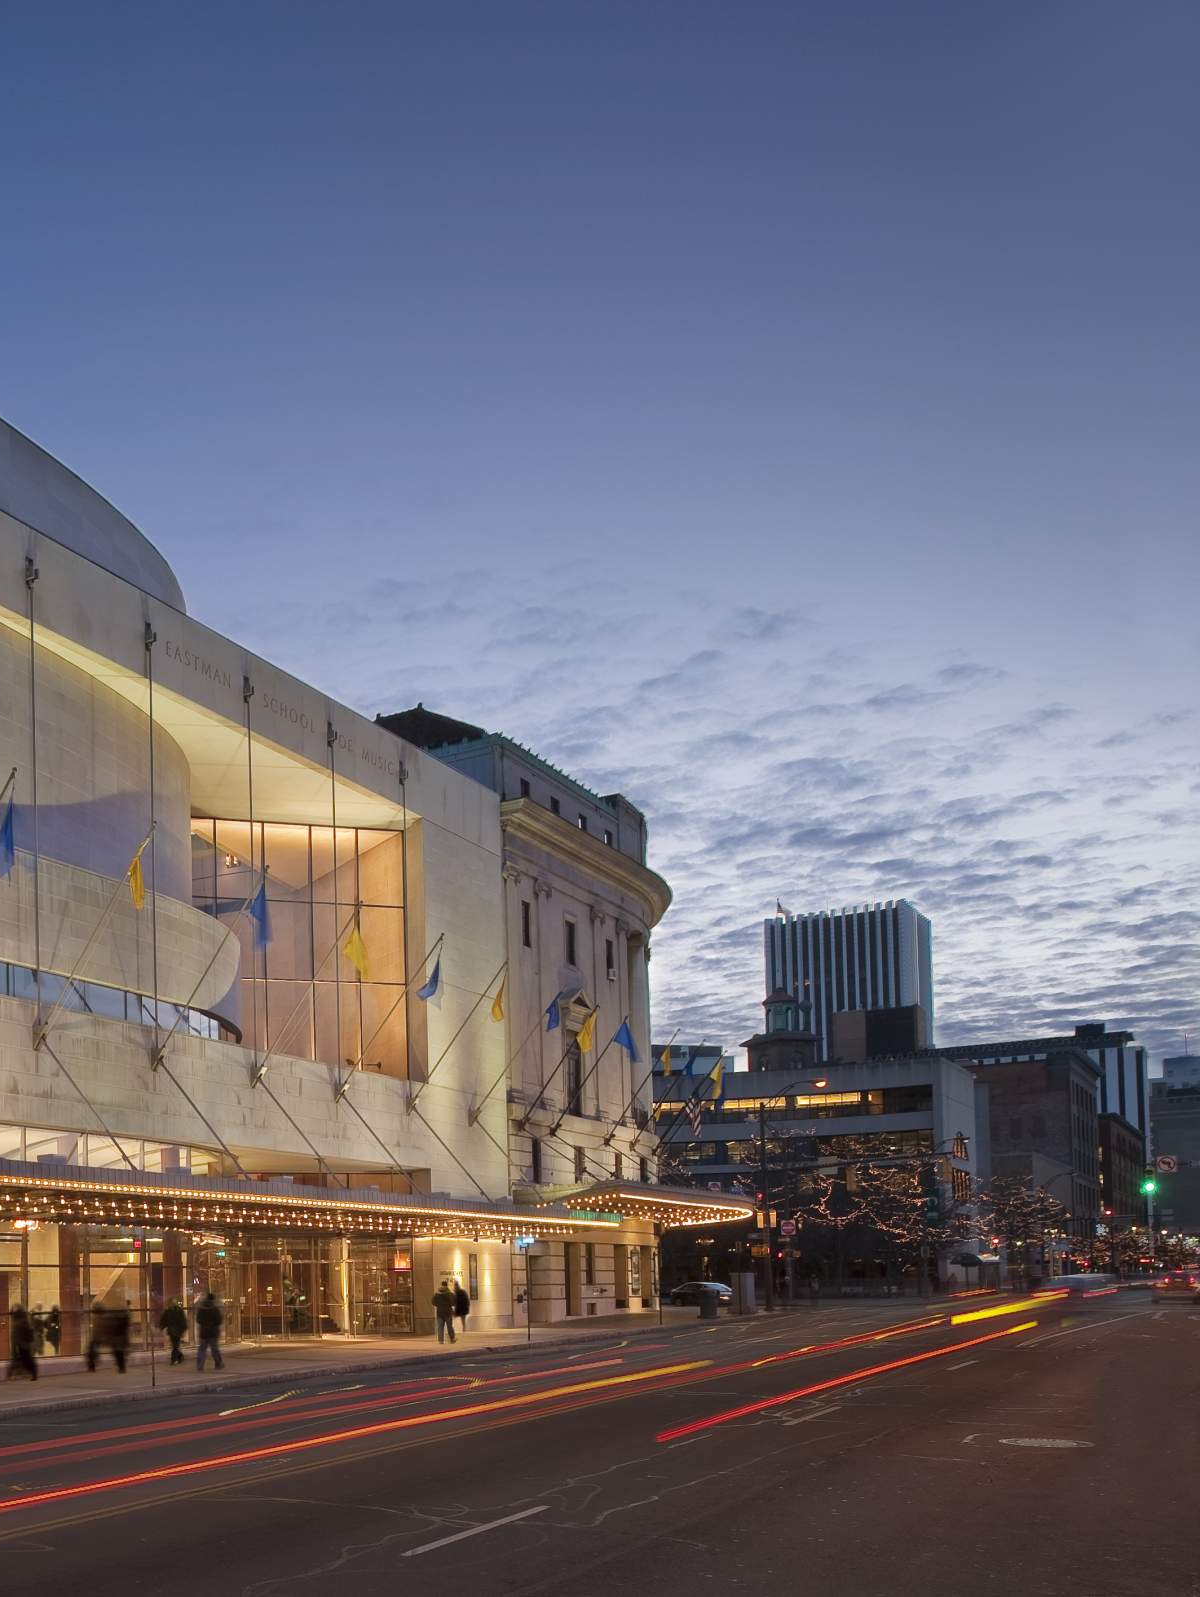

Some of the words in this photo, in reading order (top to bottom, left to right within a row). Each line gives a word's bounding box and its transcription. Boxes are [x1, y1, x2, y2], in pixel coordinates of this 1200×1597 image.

[166, 640, 232, 689] EASTMAN
[263, 693, 316, 734] SCHOOL
[361, 746, 395, 776] MUSIC
